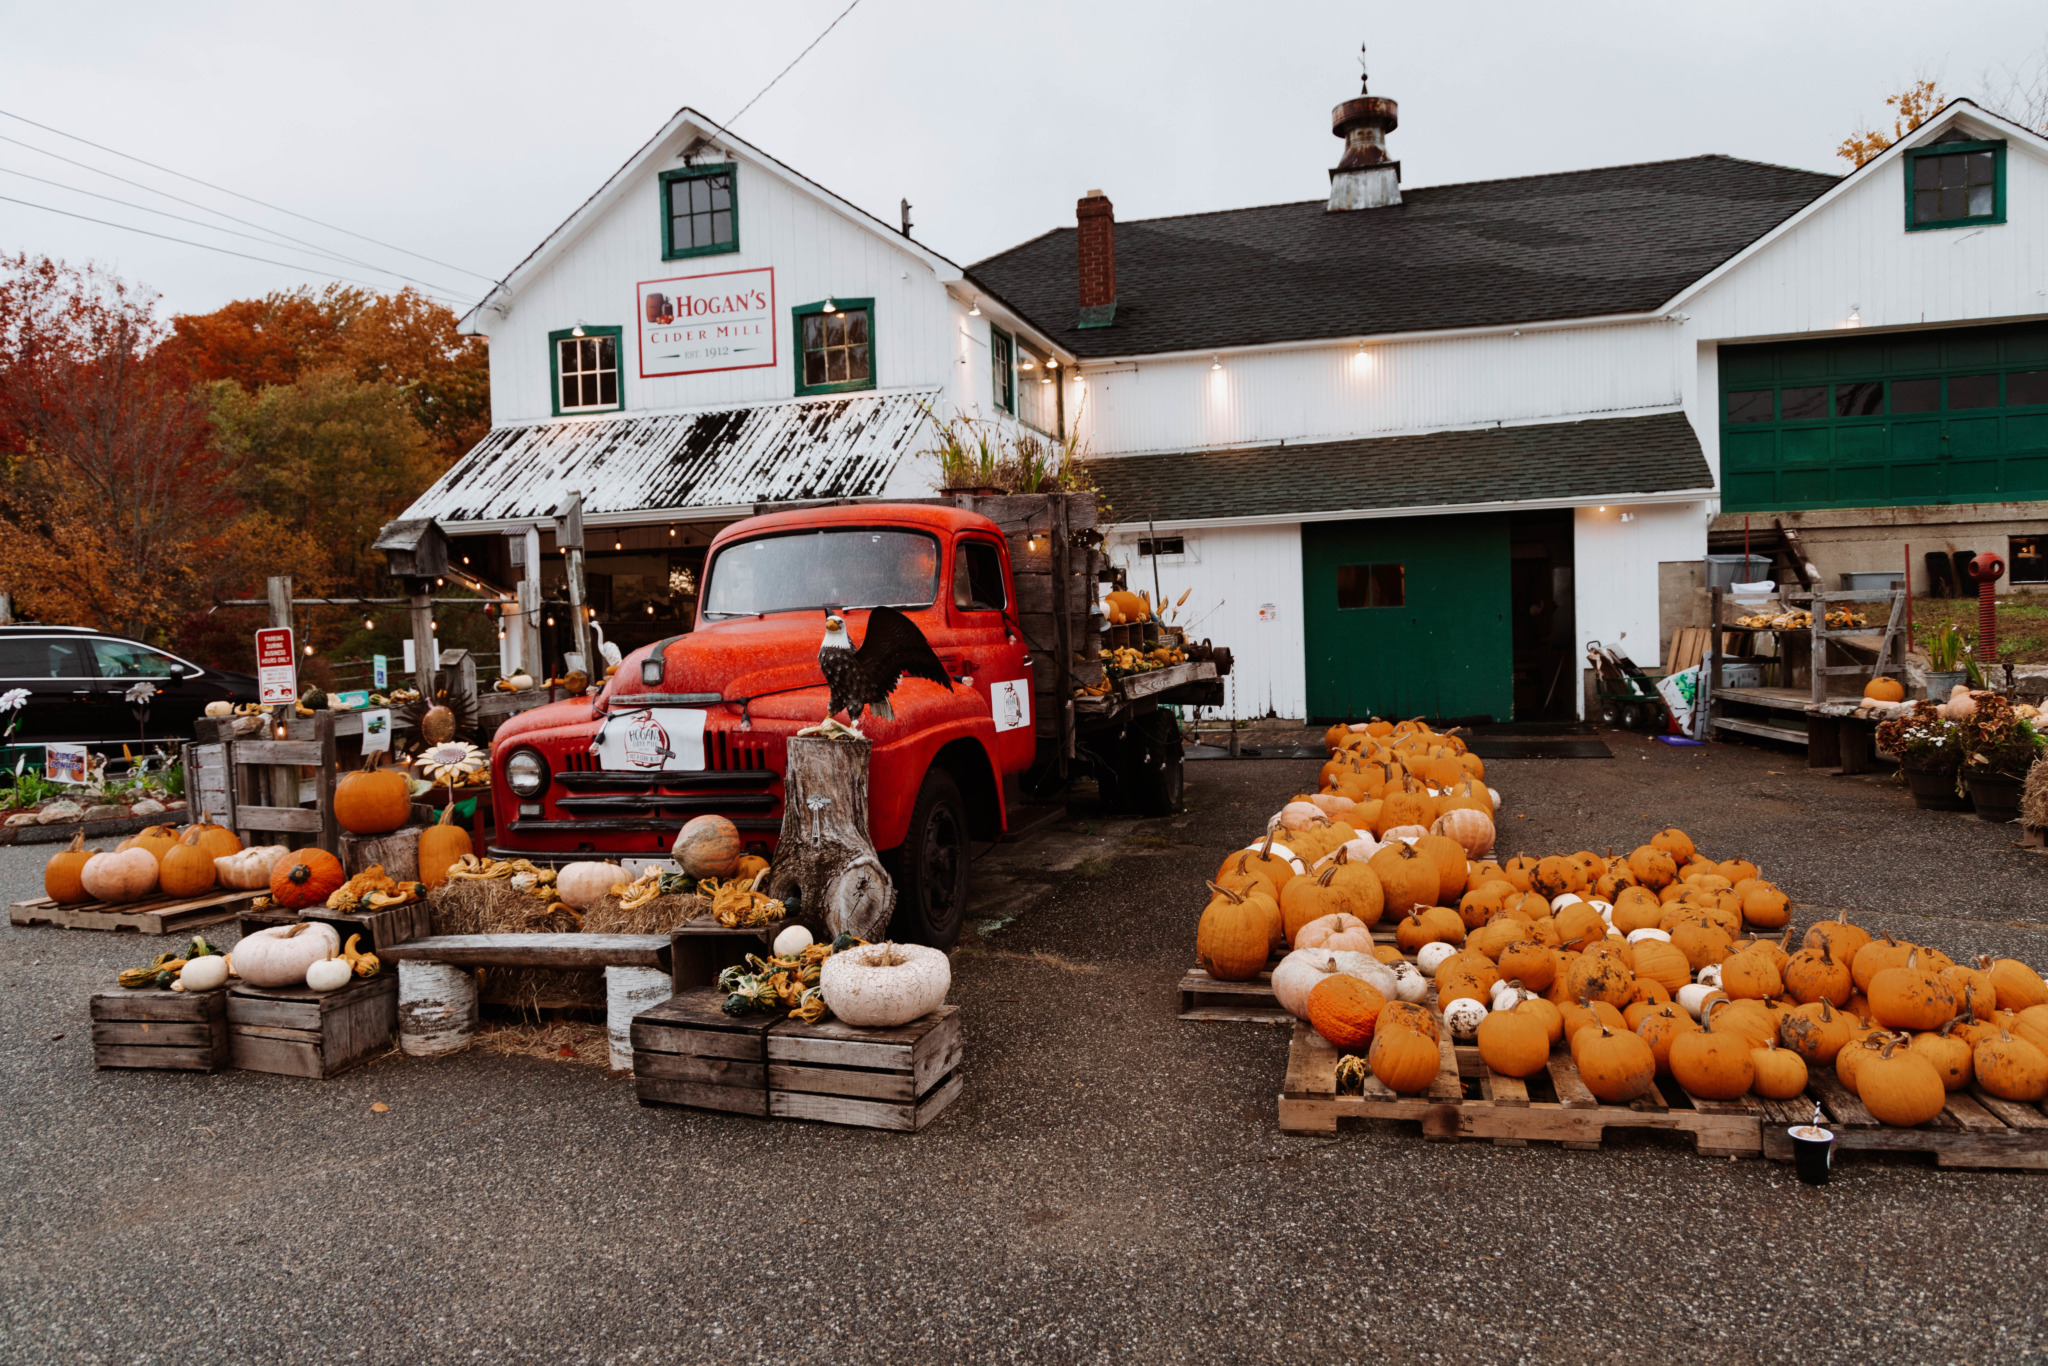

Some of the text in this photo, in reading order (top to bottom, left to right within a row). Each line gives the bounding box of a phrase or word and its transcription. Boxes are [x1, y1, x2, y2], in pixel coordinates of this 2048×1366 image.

[676, 289, 766, 318] HOGAN'S
[651, 325, 762, 344] CIDER MILL
[705, 346, 729, 359] 1912
[264, 649, 286, 657] BUSINESS
[51, 760, 81, 770] DONUTS
